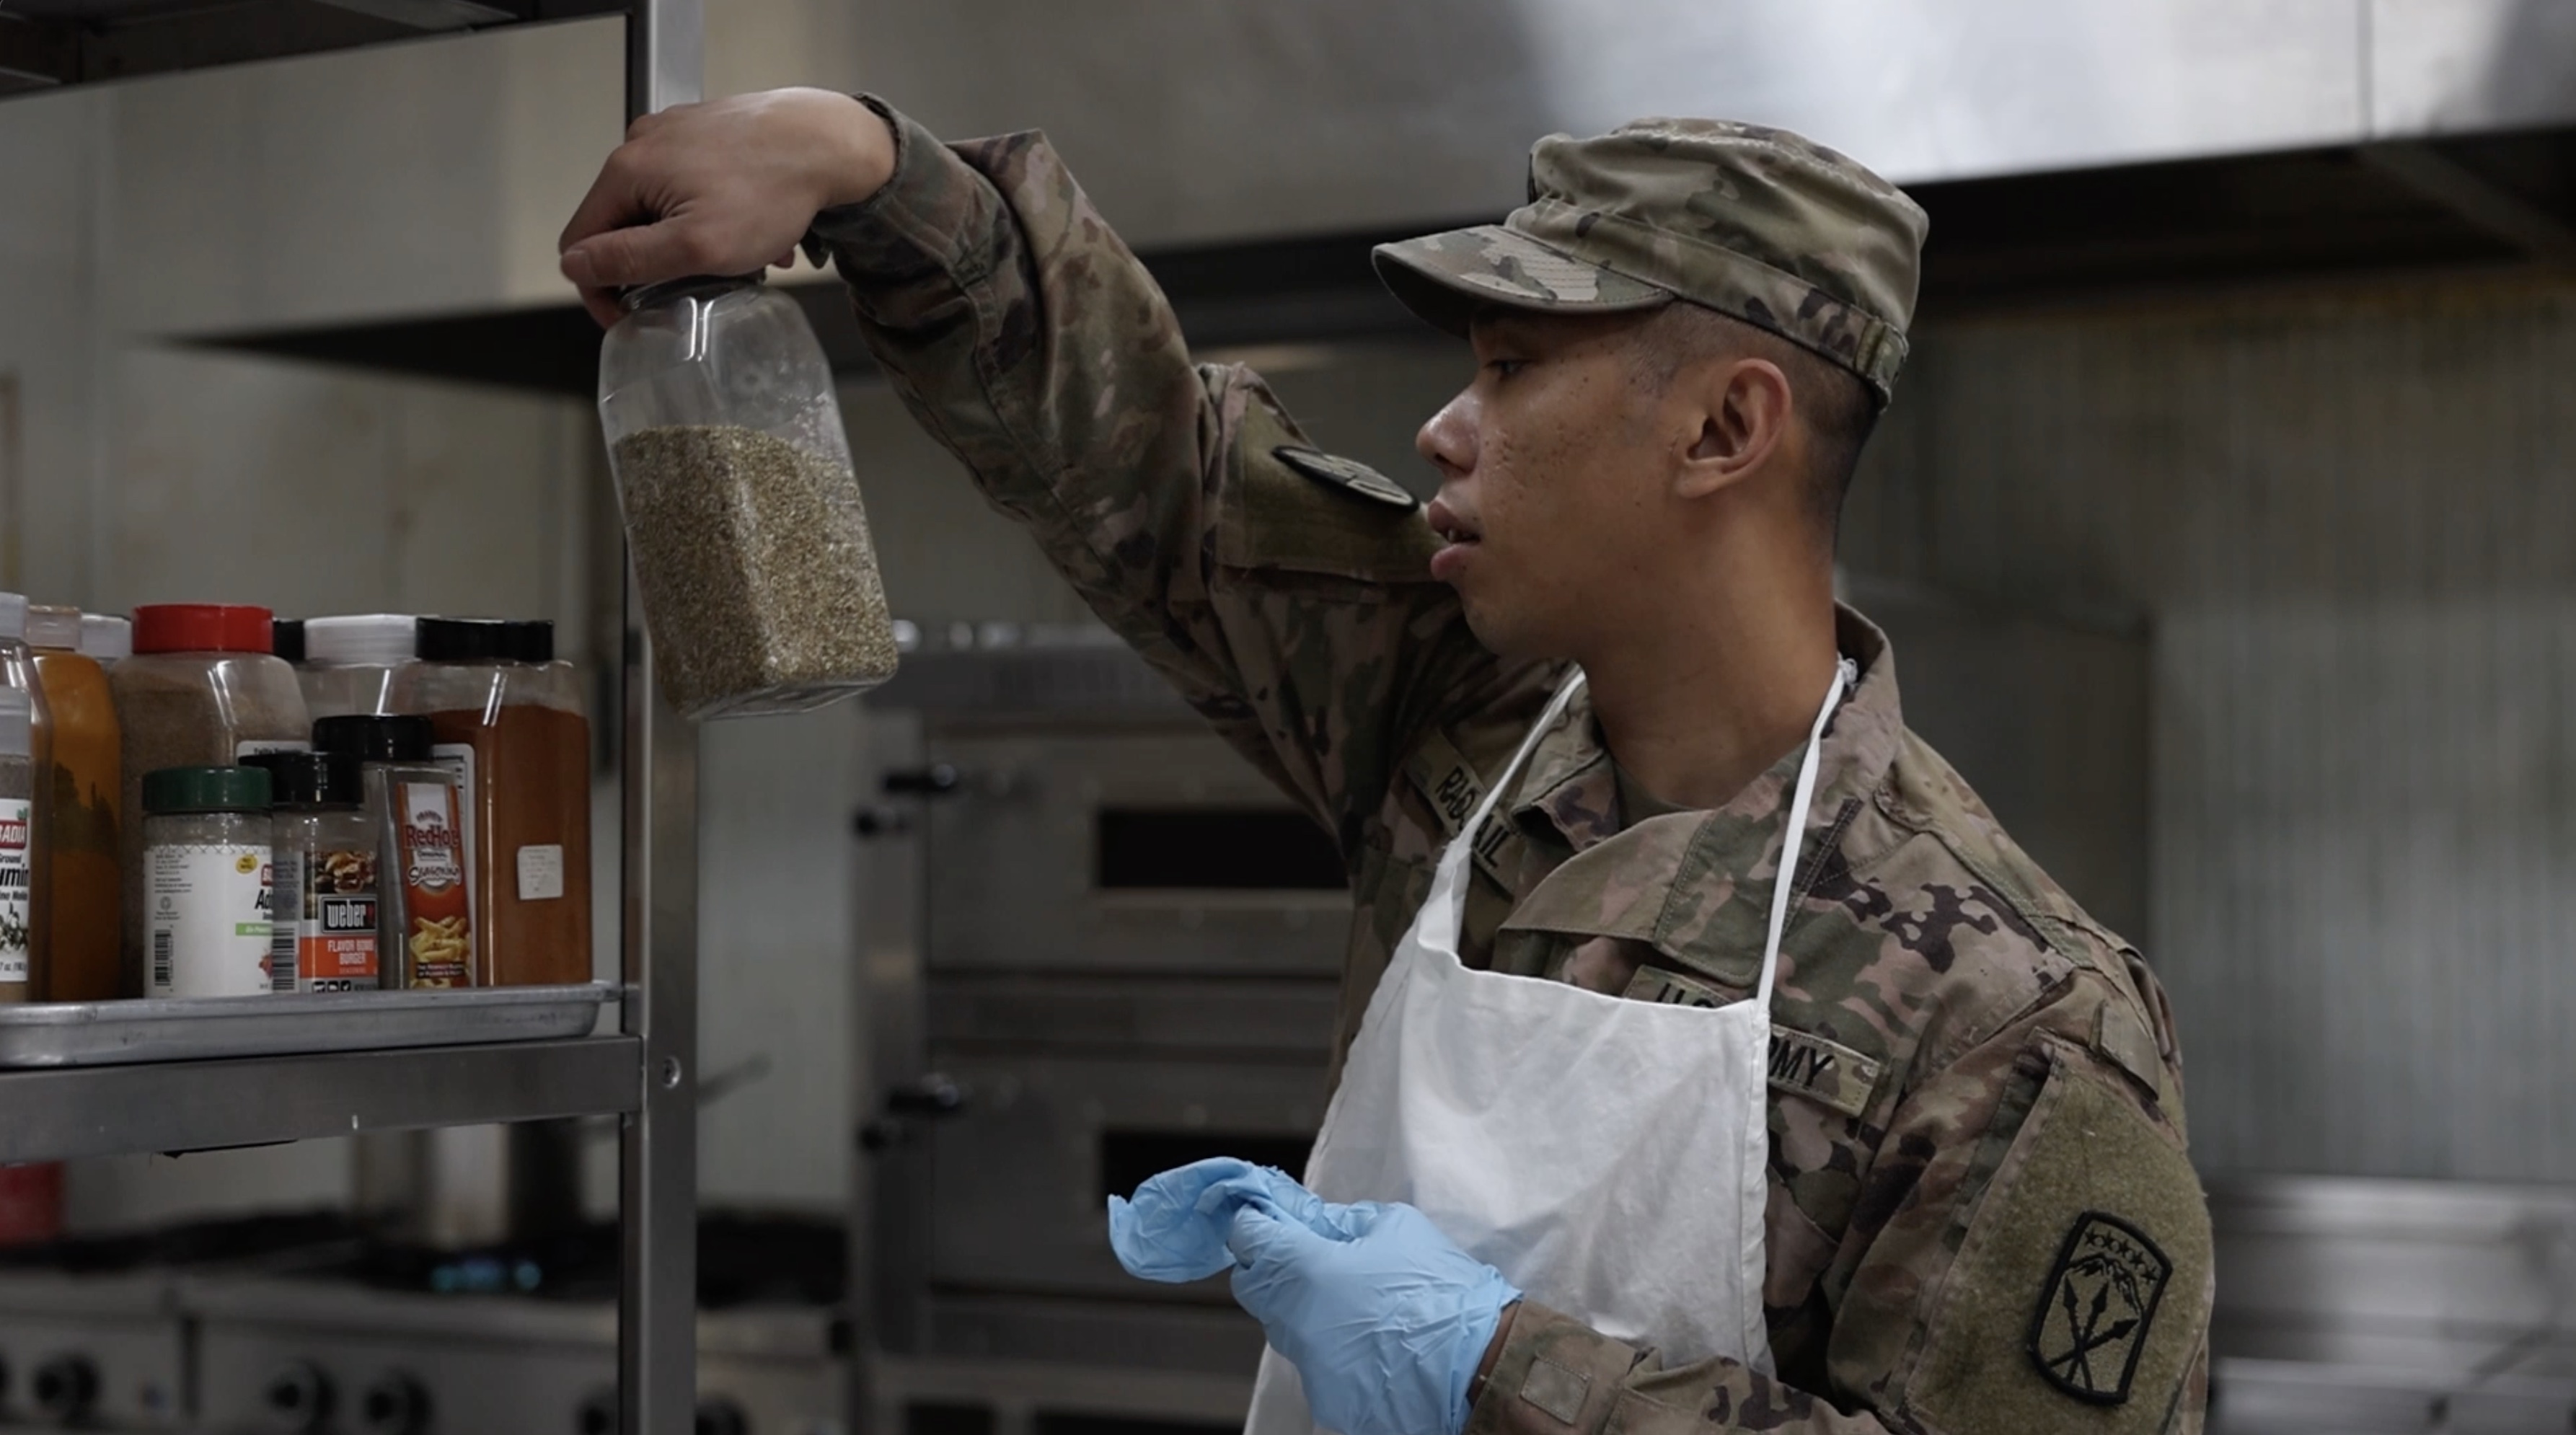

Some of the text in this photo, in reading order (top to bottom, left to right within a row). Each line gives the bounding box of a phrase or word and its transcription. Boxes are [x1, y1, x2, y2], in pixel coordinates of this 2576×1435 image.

[327, 899, 366, 928] weber
[328, 940, 355, 952] FLAVOR
[339, 953, 366, 965] BURGER
[1768, 1036, 1835, 1087] MY
